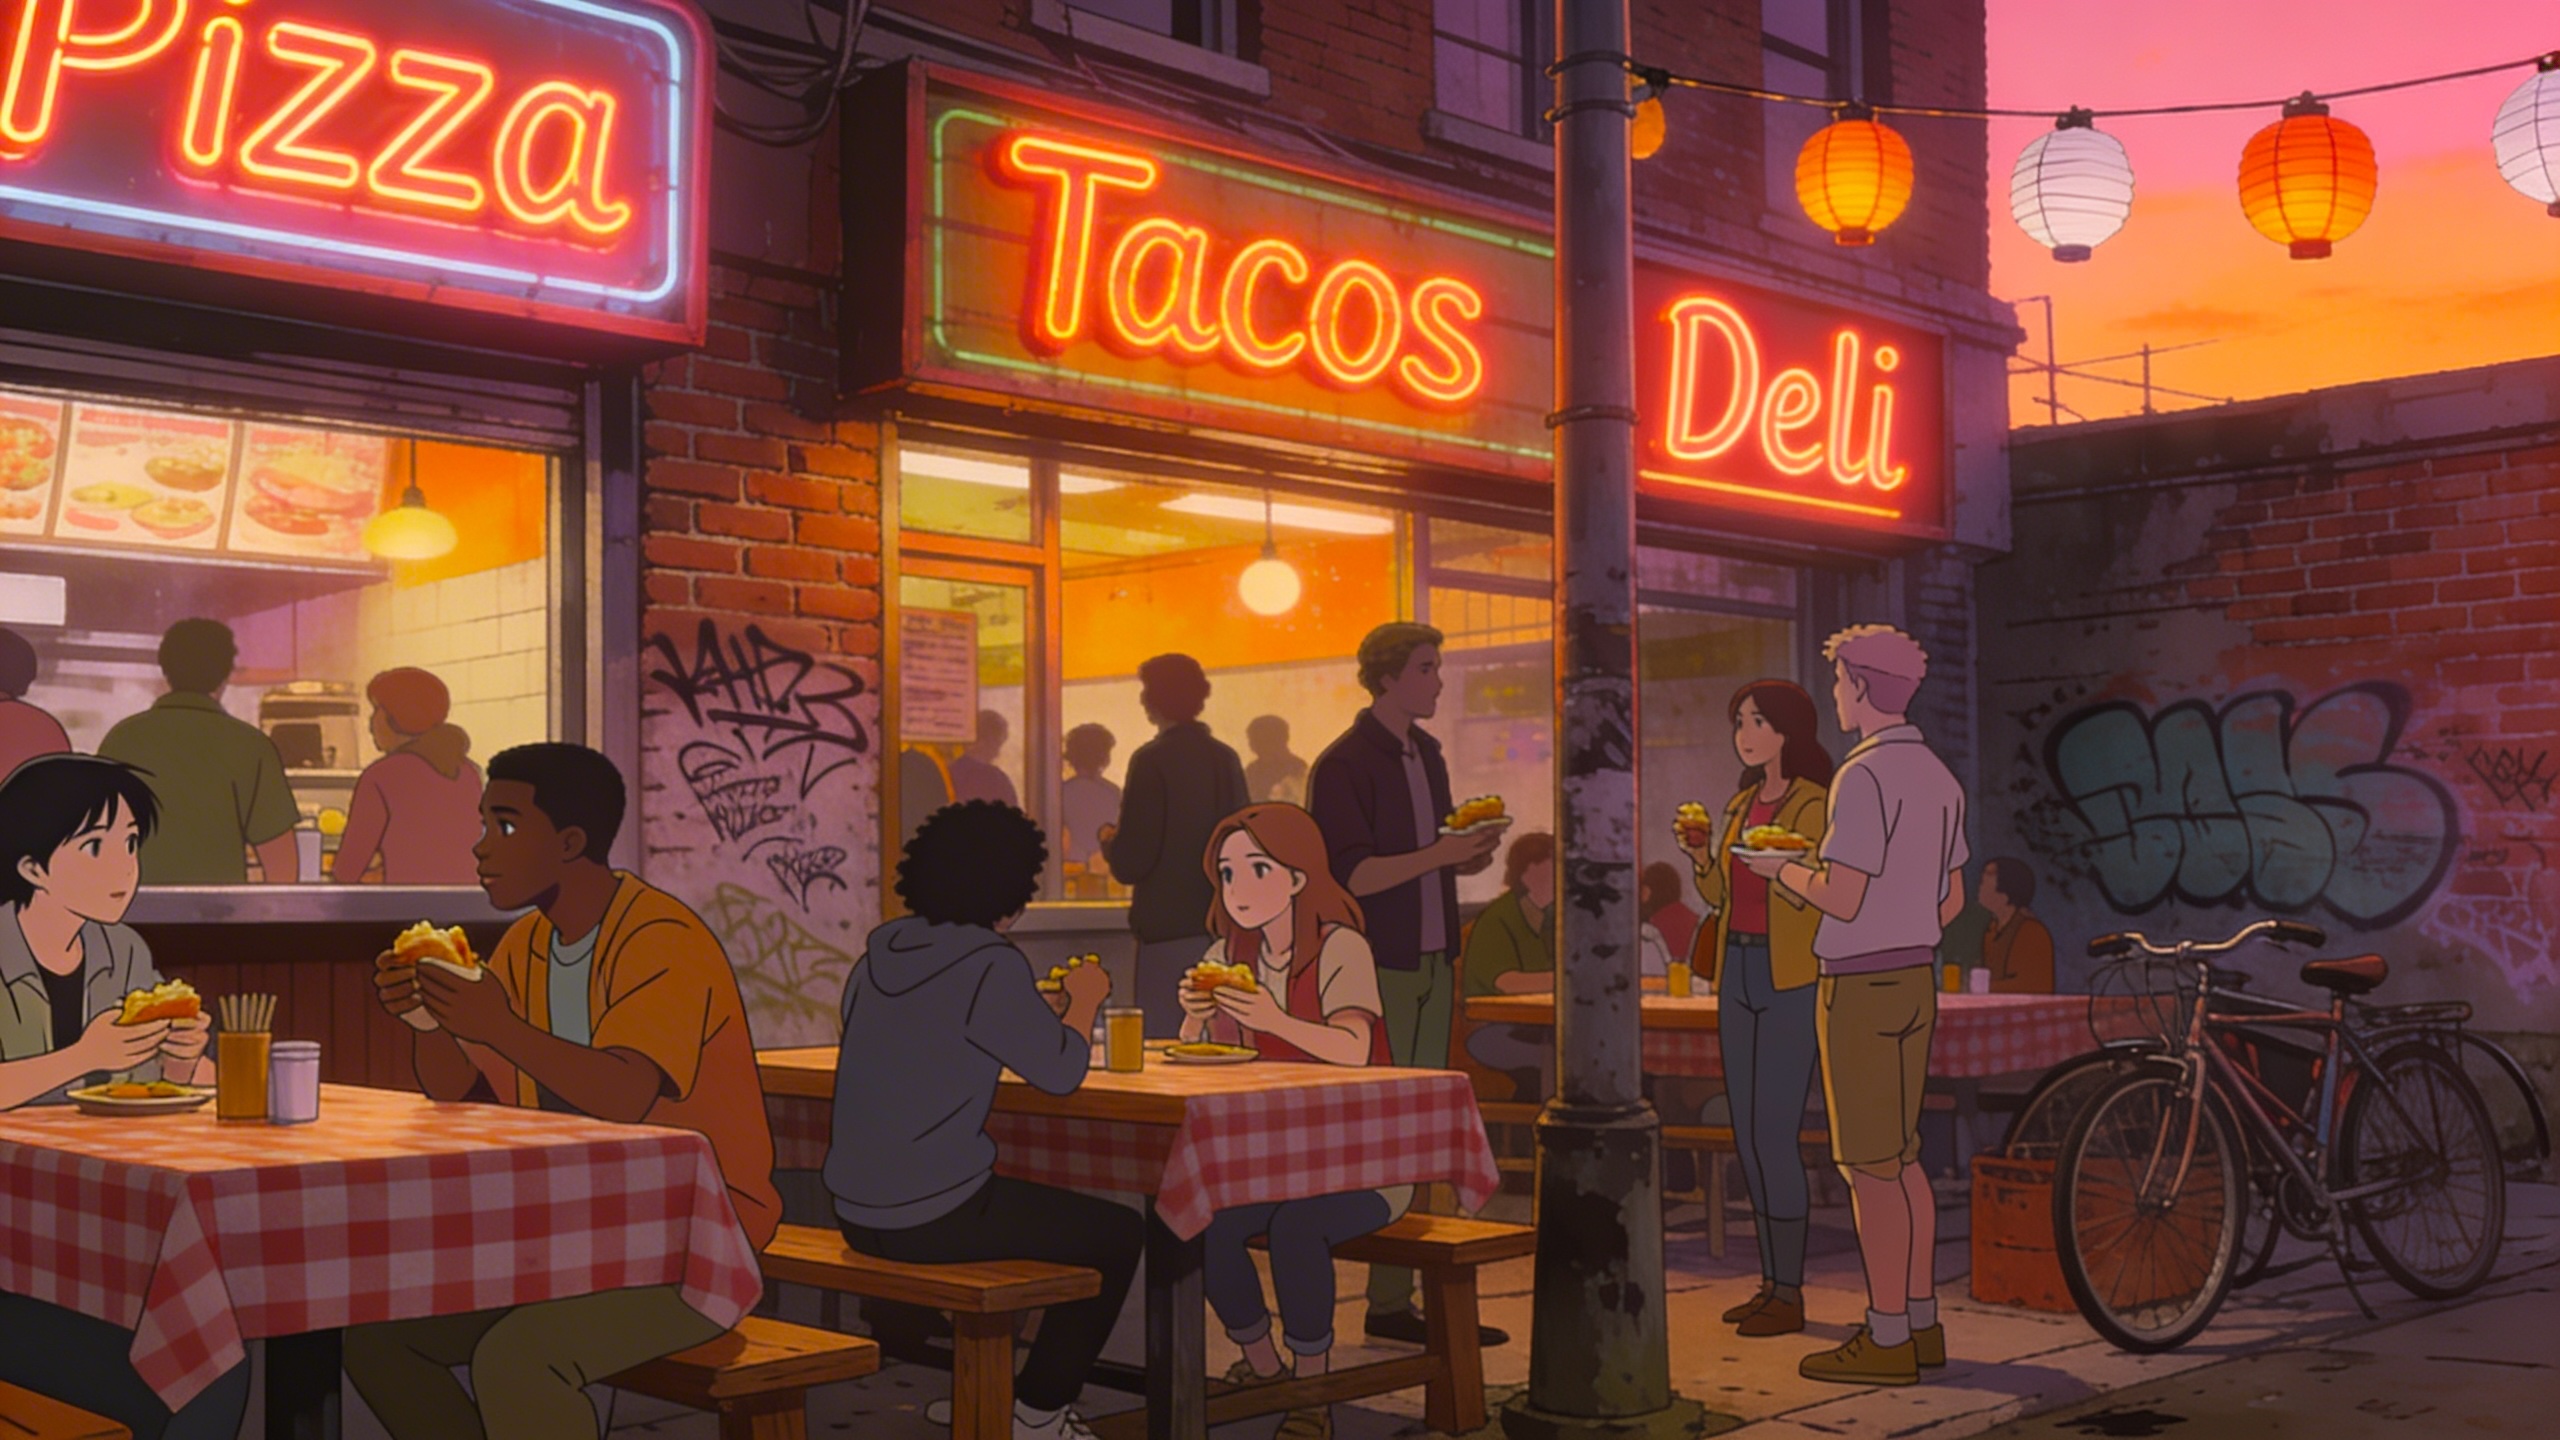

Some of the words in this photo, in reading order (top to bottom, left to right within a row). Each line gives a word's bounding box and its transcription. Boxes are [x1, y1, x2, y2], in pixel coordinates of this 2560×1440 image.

[0, 0, 632, 235] Pizza
[1008, 135, 1484, 402] Tacos
[1666, 296, 1907, 491] Deli
